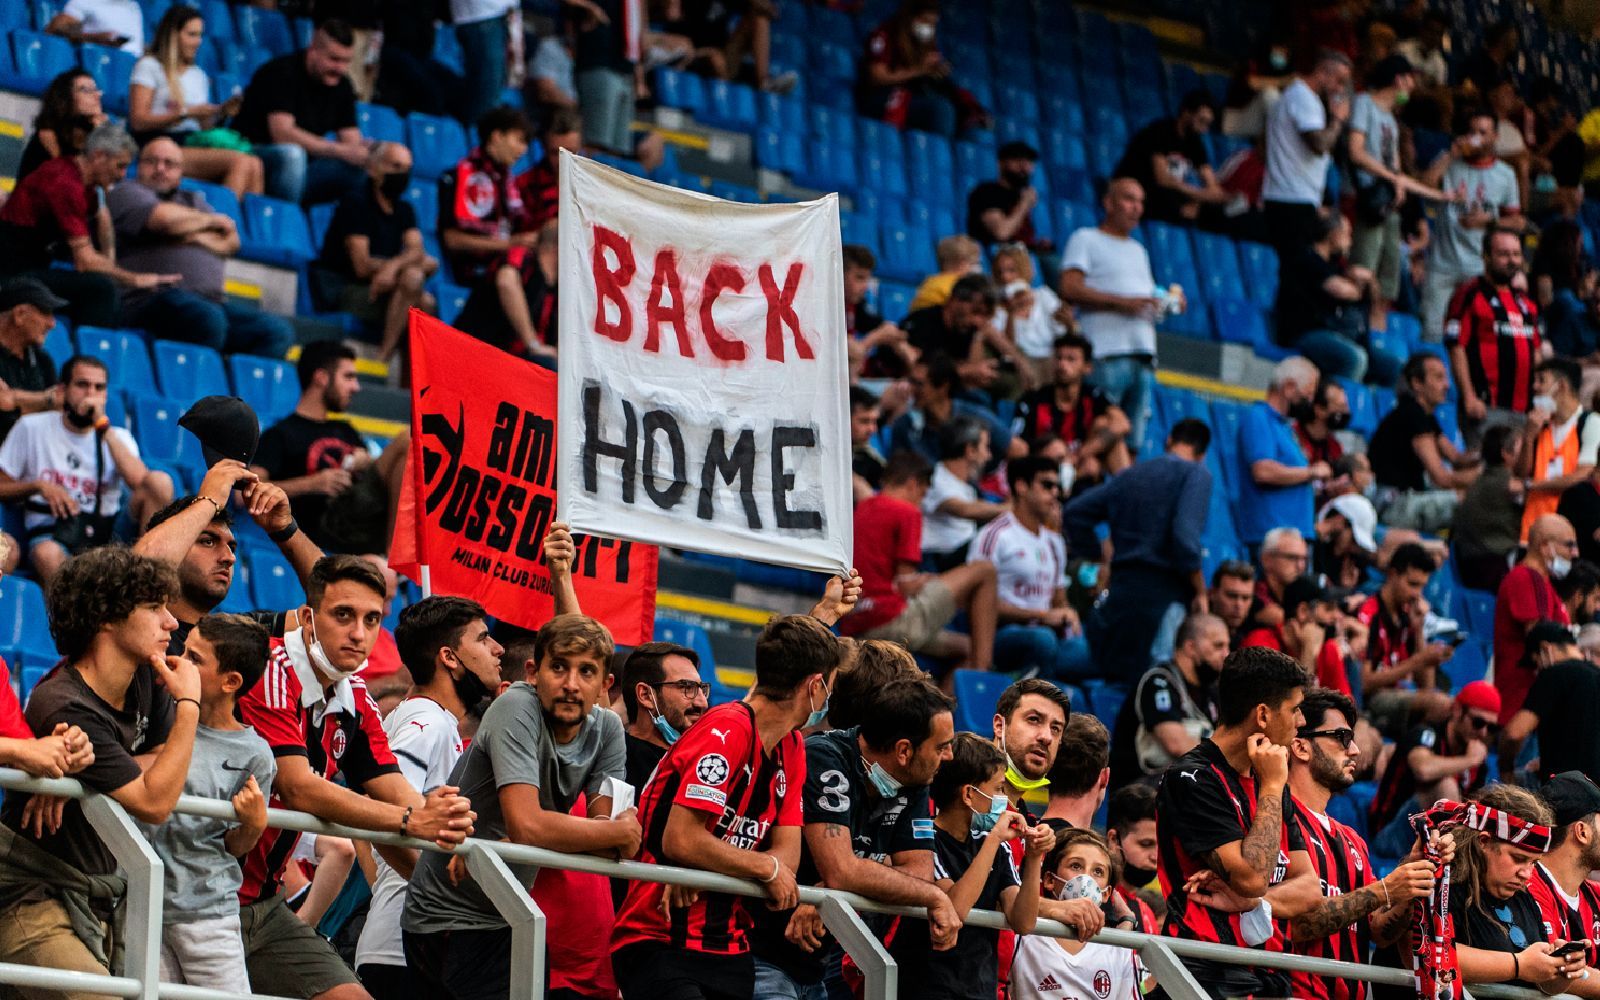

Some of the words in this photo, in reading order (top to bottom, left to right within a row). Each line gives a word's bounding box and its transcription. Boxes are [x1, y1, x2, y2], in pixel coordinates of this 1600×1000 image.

[592, 224, 815, 363] BACK
[581, 384, 823, 529] HOME
[451, 547, 492, 574] MILAN
[493, 561, 530, 588] CLUB
[817, 769, 851, 812] 3
